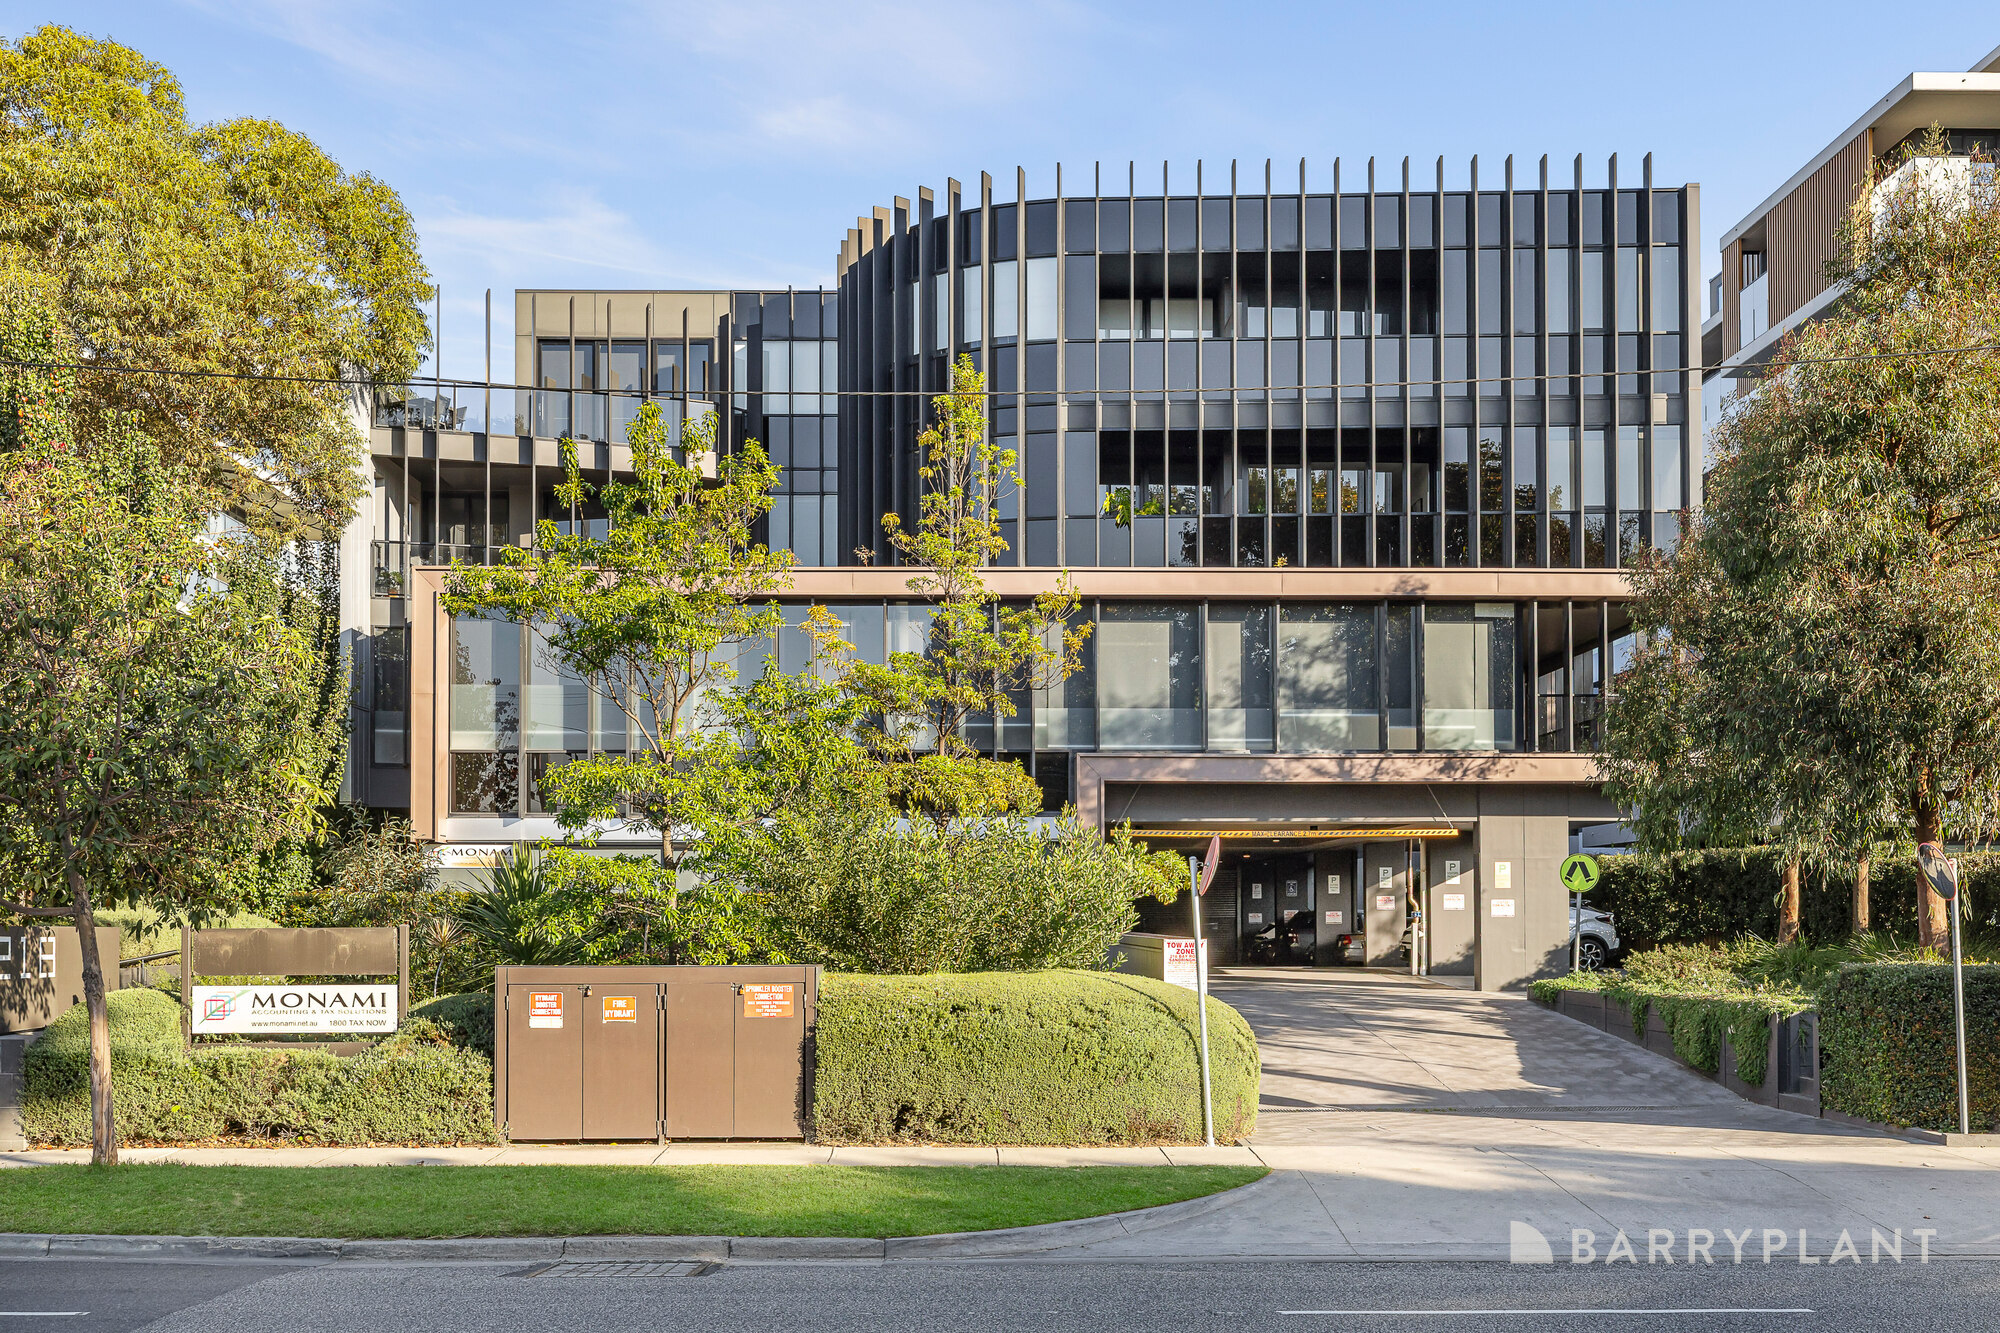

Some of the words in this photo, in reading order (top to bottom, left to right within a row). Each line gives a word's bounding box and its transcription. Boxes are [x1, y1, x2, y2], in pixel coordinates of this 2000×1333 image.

[1450, 863, 1456, 871] P
[1499, 864, 1506, 872] P
[252, 992, 387, 1008] MONAMI
